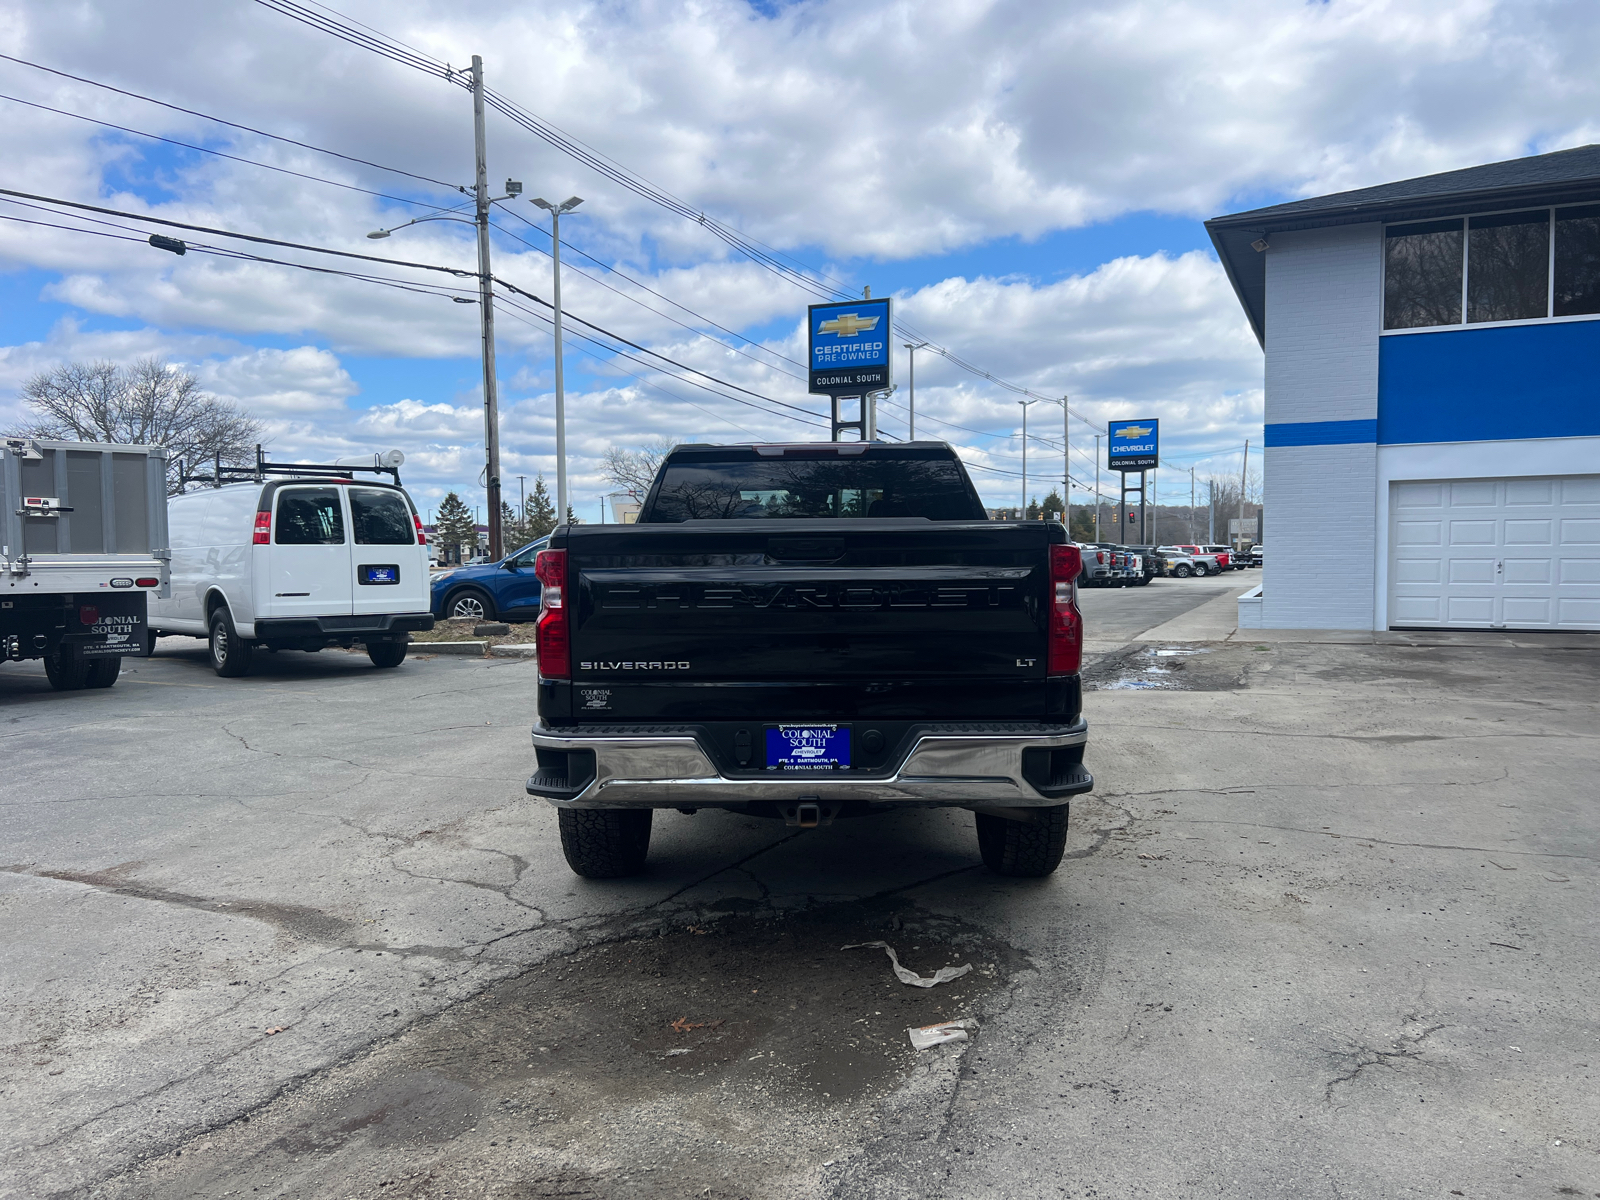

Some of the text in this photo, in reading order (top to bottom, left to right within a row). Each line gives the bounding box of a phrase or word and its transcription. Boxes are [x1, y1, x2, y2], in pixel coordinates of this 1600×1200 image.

[815, 342, 882, 354] CERTIFIED
[818, 351, 879, 362] PRE-OWNED
[816, 374, 881, 385] COLONIAL SOUTH
[1112, 444, 1154, 452] CHEVROLET
[602, 586, 1022, 608] CHEVROLET
[84, 616, 140, 625] LONIAL
[91, 625, 132, 634] SOUTH
[580, 661, 690, 670] SILVERADO
[1016, 658, 1036, 667] LT
[782, 730, 834, 738] COLONIAL
[790, 738, 826, 747] SOUTH
